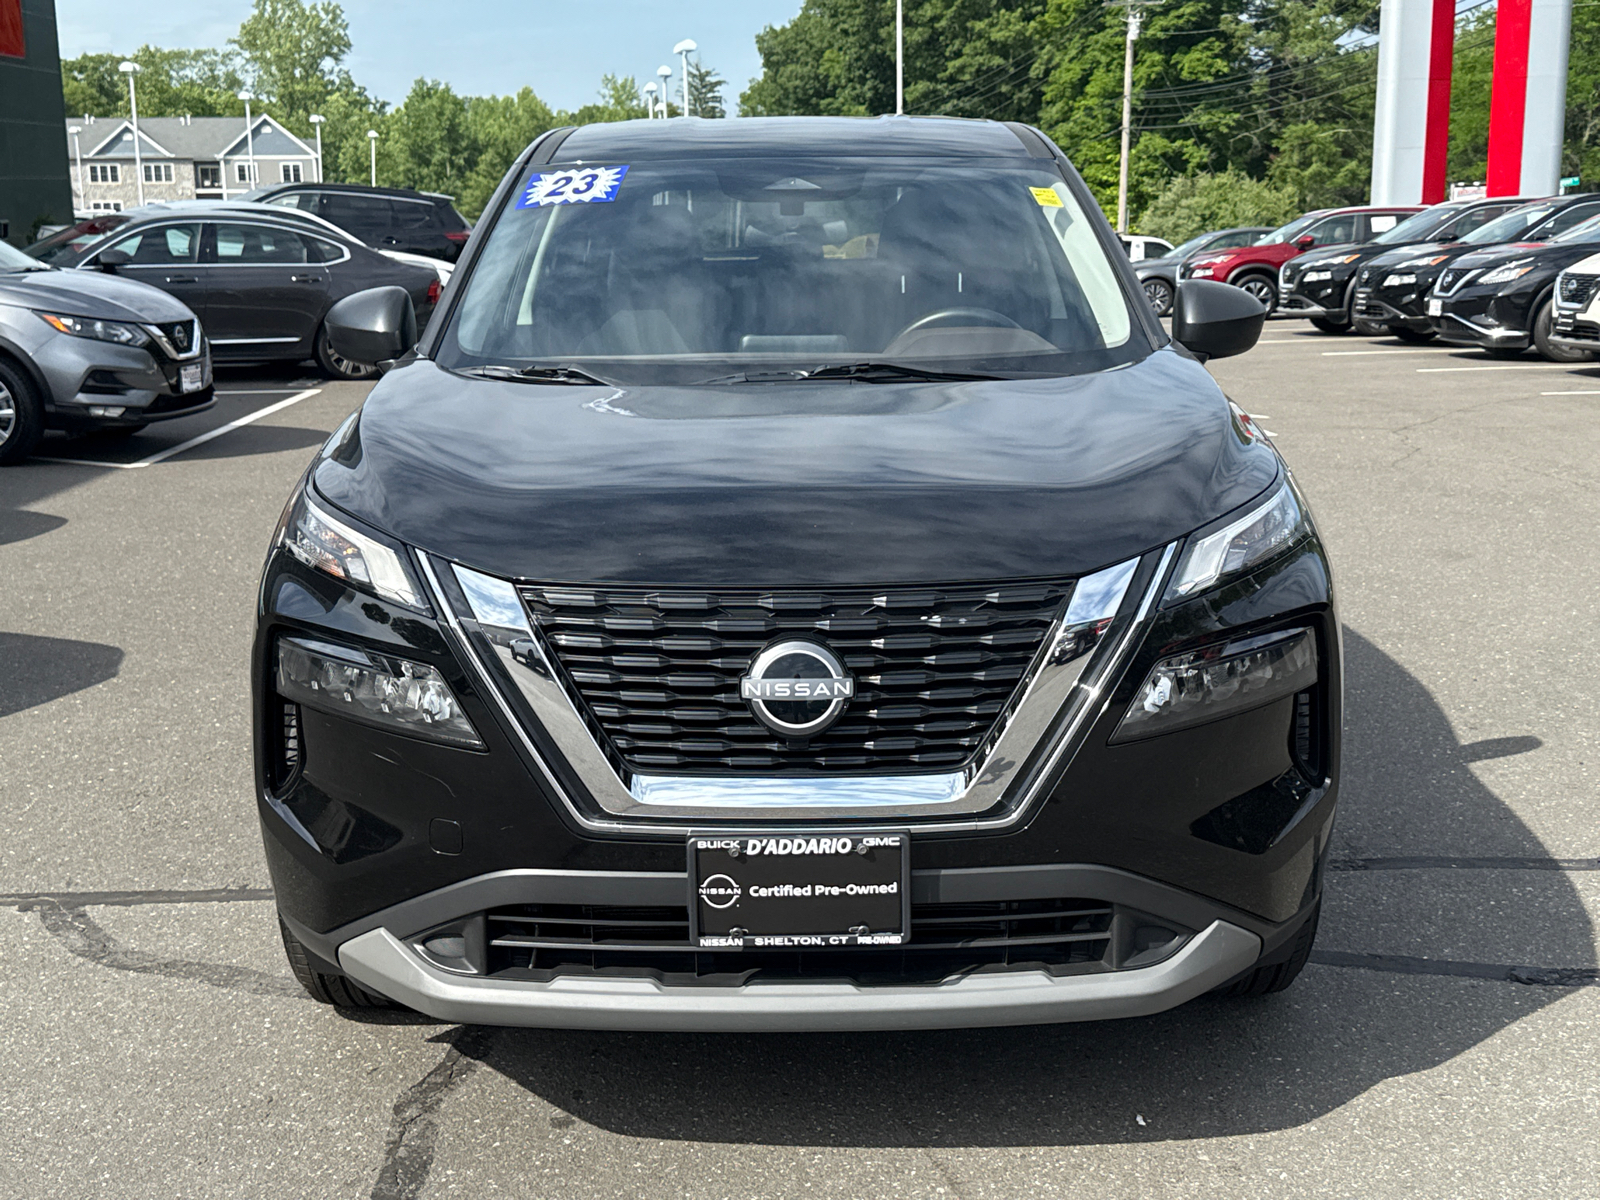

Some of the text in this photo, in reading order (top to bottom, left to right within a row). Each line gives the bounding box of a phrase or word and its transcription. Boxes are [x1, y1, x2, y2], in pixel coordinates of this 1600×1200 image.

[543, 173, 599, 198] 23
[744, 681, 851, 697] NISSAN
[697, 840, 740, 849] BUICK
[746, 837, 852, 855] D'ADDARIO
[863, 837, 900, 846] GMC
[698, 887, 741, 895] NISSAN
[749, 882, 898, 898] Certified Pre-Owned
[700, 937, 743, 946] NISSAN
[755, 936, 848, 946] SHELTON, CT
